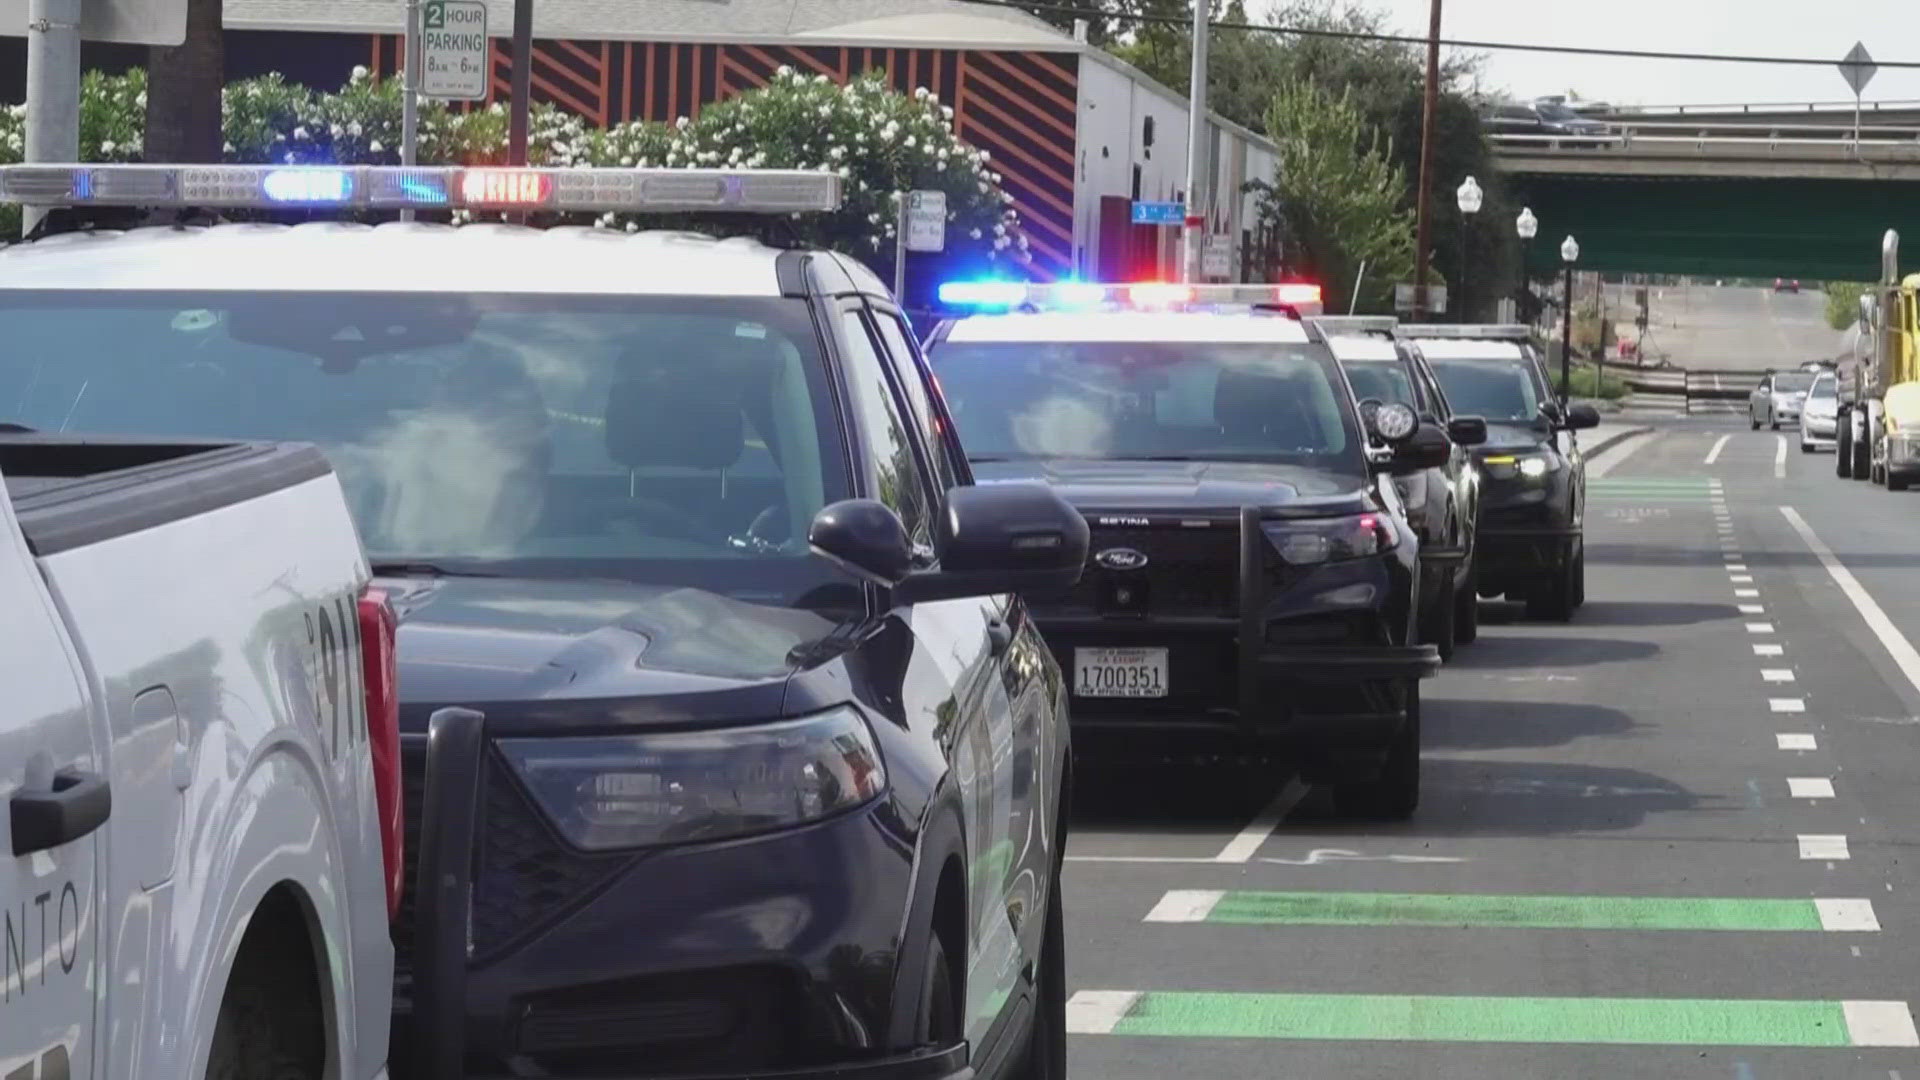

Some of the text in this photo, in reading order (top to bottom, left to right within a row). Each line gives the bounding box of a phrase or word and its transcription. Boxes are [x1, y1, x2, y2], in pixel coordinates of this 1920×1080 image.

[429, 5, 482, 25] 2 HOUR
[426, 32, 482, 51] PARKING
[318, 593, 367, 761] 911
[1081, 666, 1161, 689] 1700351
